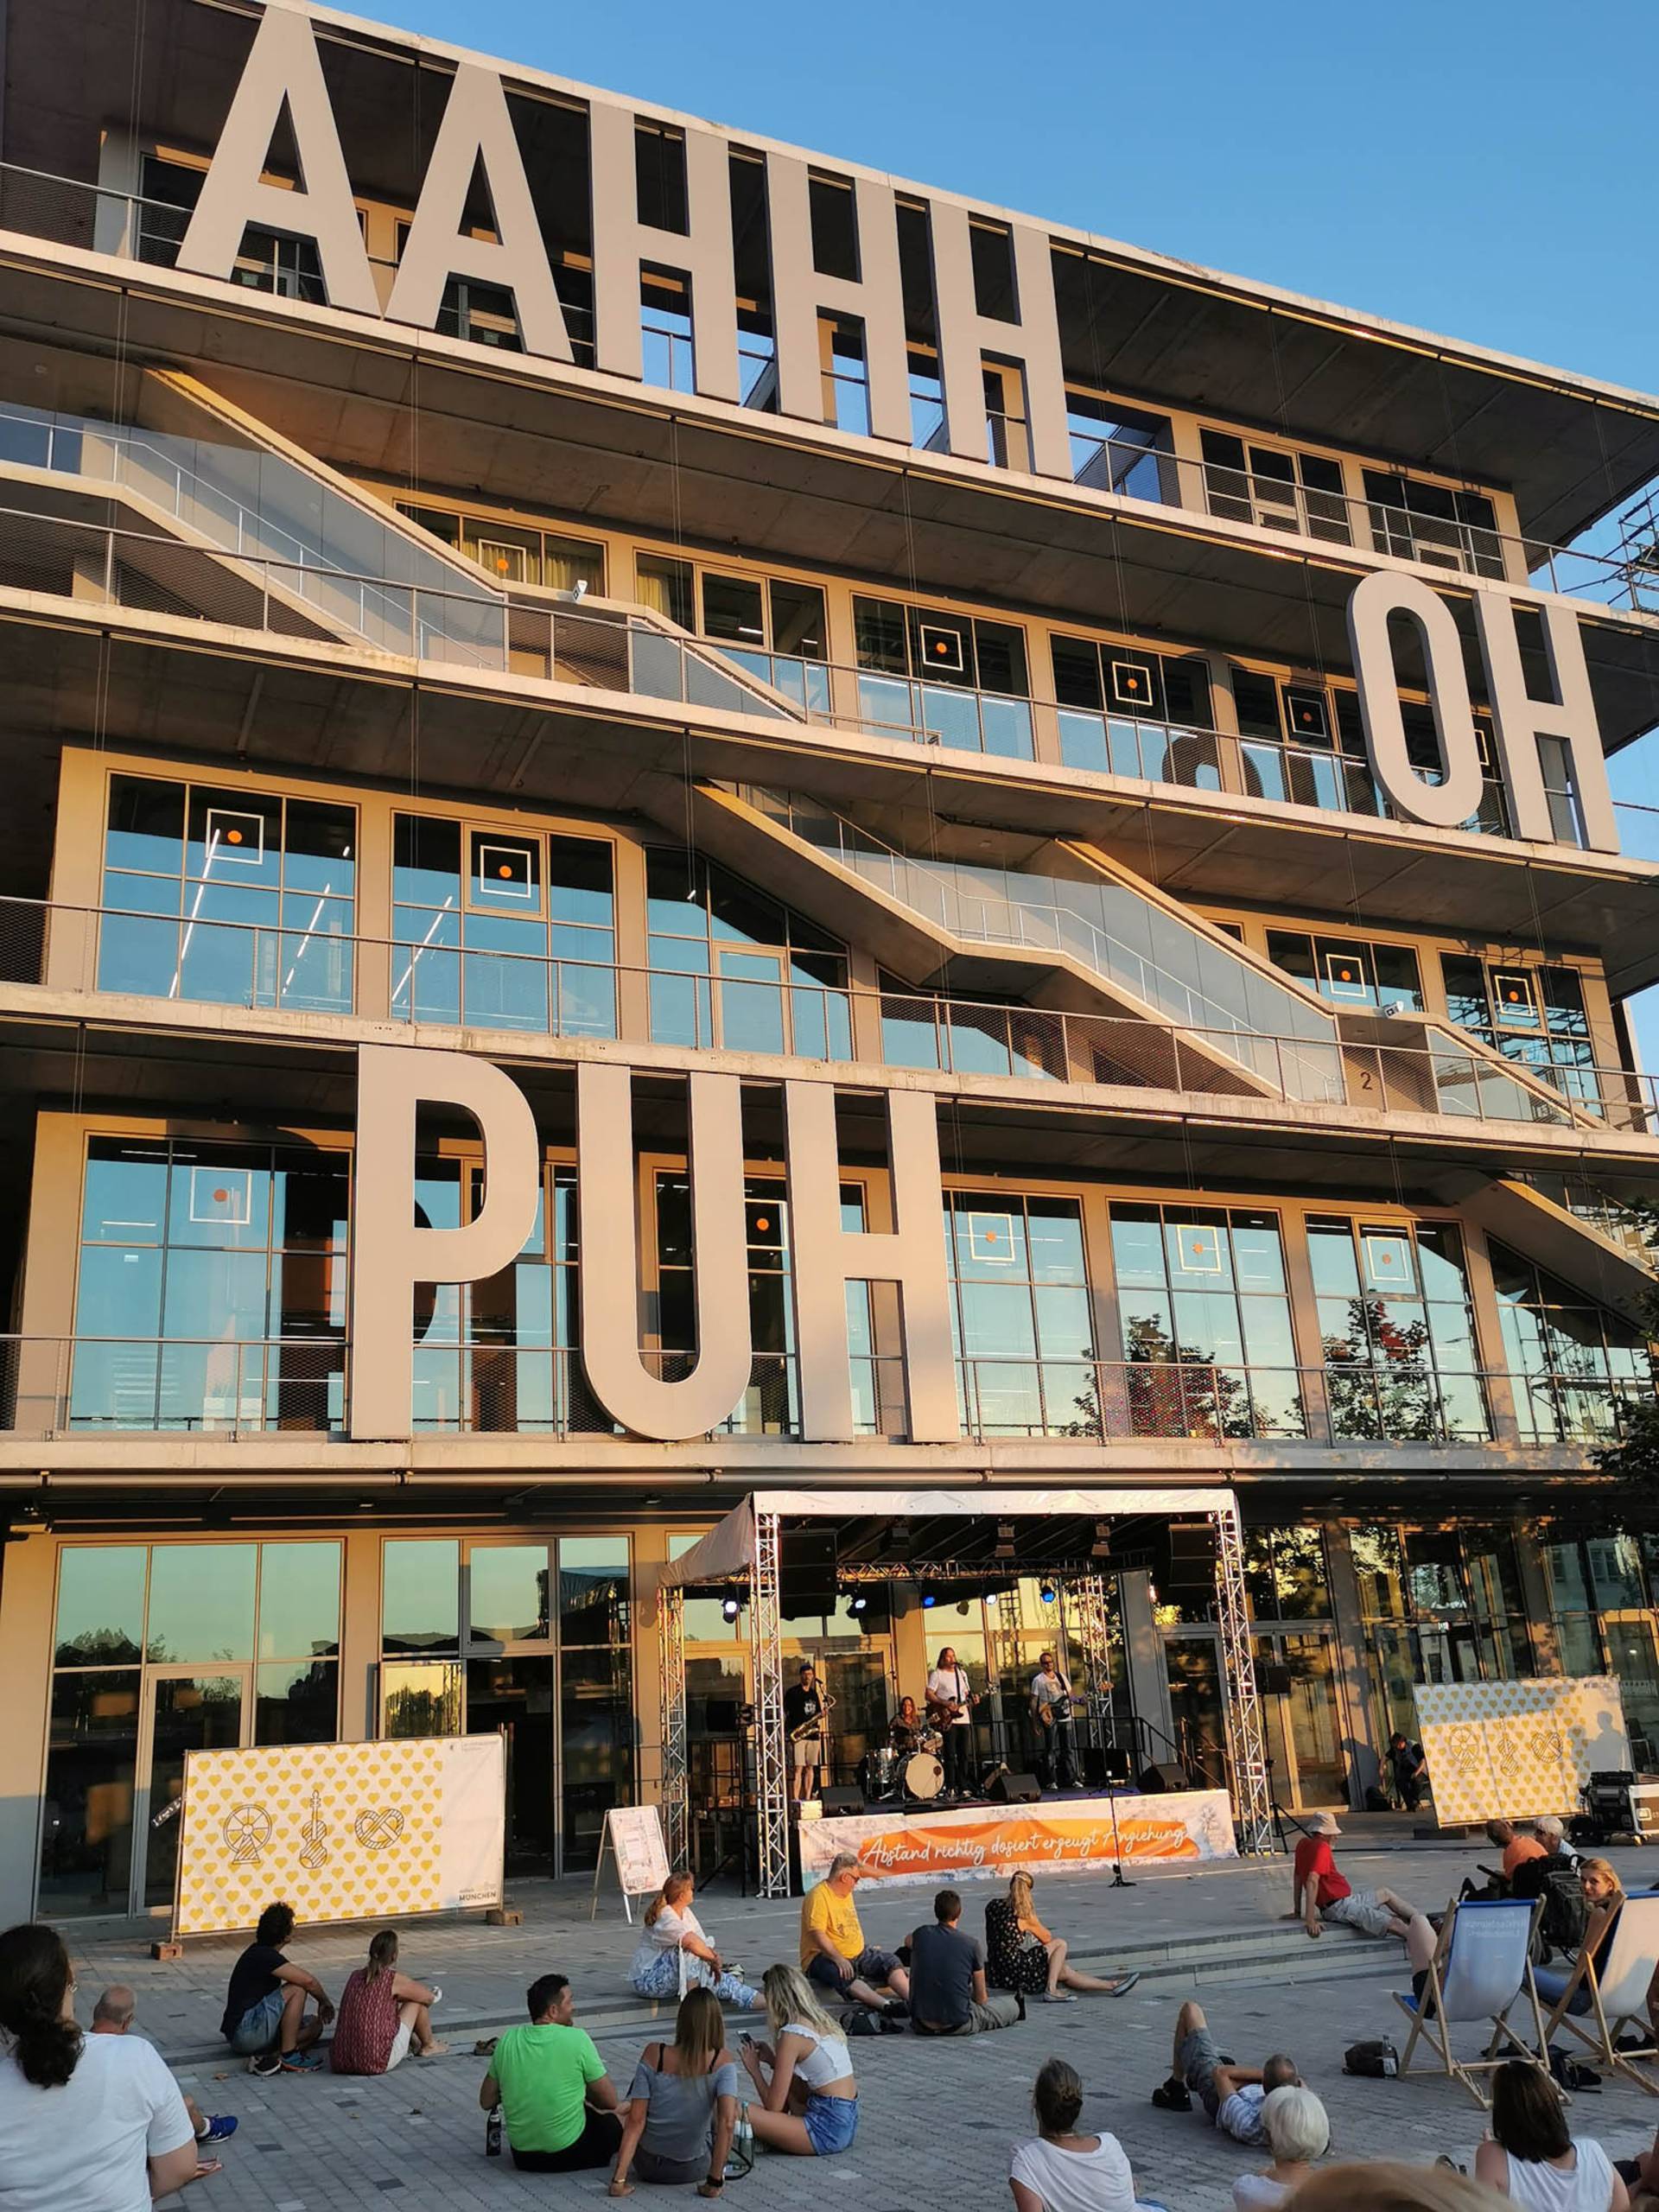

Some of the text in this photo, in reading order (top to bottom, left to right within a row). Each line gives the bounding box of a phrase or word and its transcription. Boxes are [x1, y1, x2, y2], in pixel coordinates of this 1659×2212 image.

[175, 3, 1074, 482] AAHHH
[1346, 569, 1622, 855] OH
[1360, 1071, 1373, 1090] 2
[350, 1043, 962, 1444] PUH
[862, 1821, 1190, 1869] Abstand richtig dosiert erzeugt Anziehung
